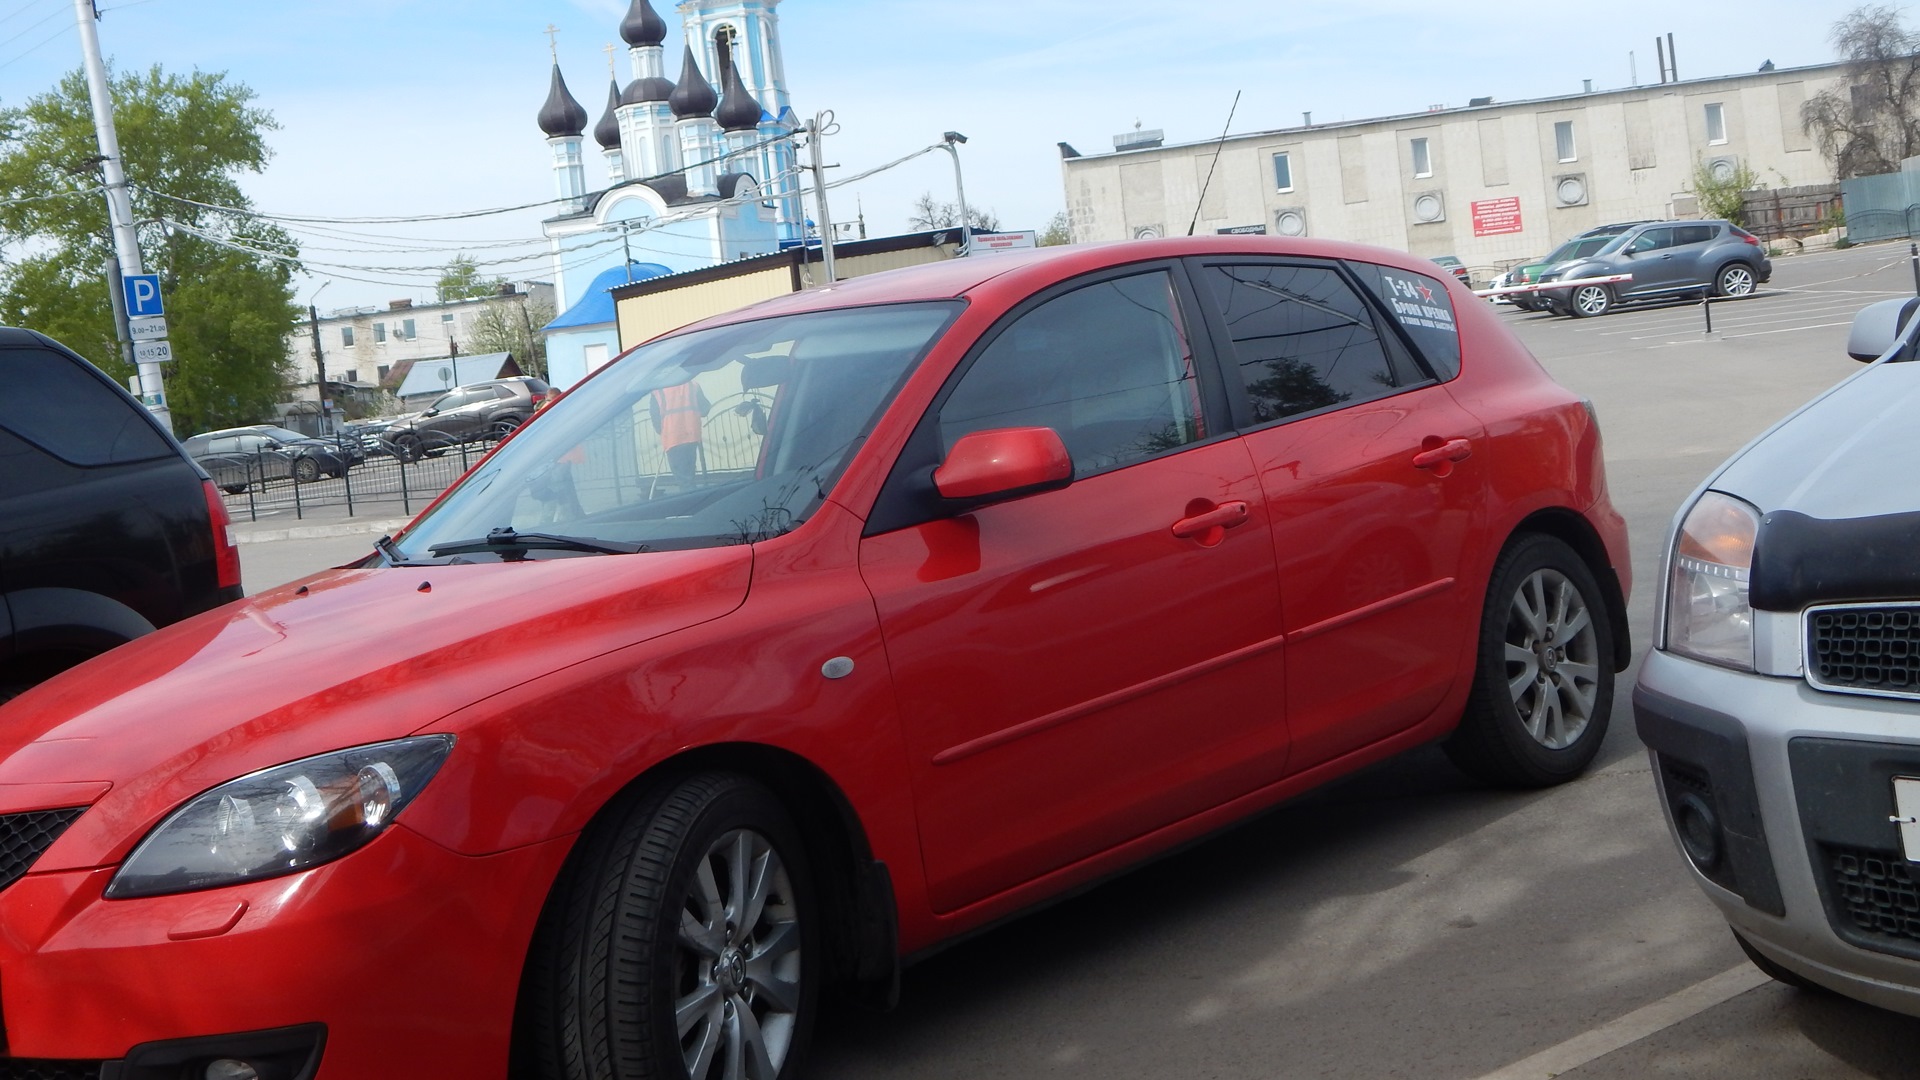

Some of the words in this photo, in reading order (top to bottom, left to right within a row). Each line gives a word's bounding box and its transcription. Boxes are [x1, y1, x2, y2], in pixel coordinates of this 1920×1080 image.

[1231, 226, 1264, 234] СВОБОДНЫХ
[133, 279, 154, 312] P
[1384, 276, 1419, 299] Т-34
[156, 346, 168, 356] 20
